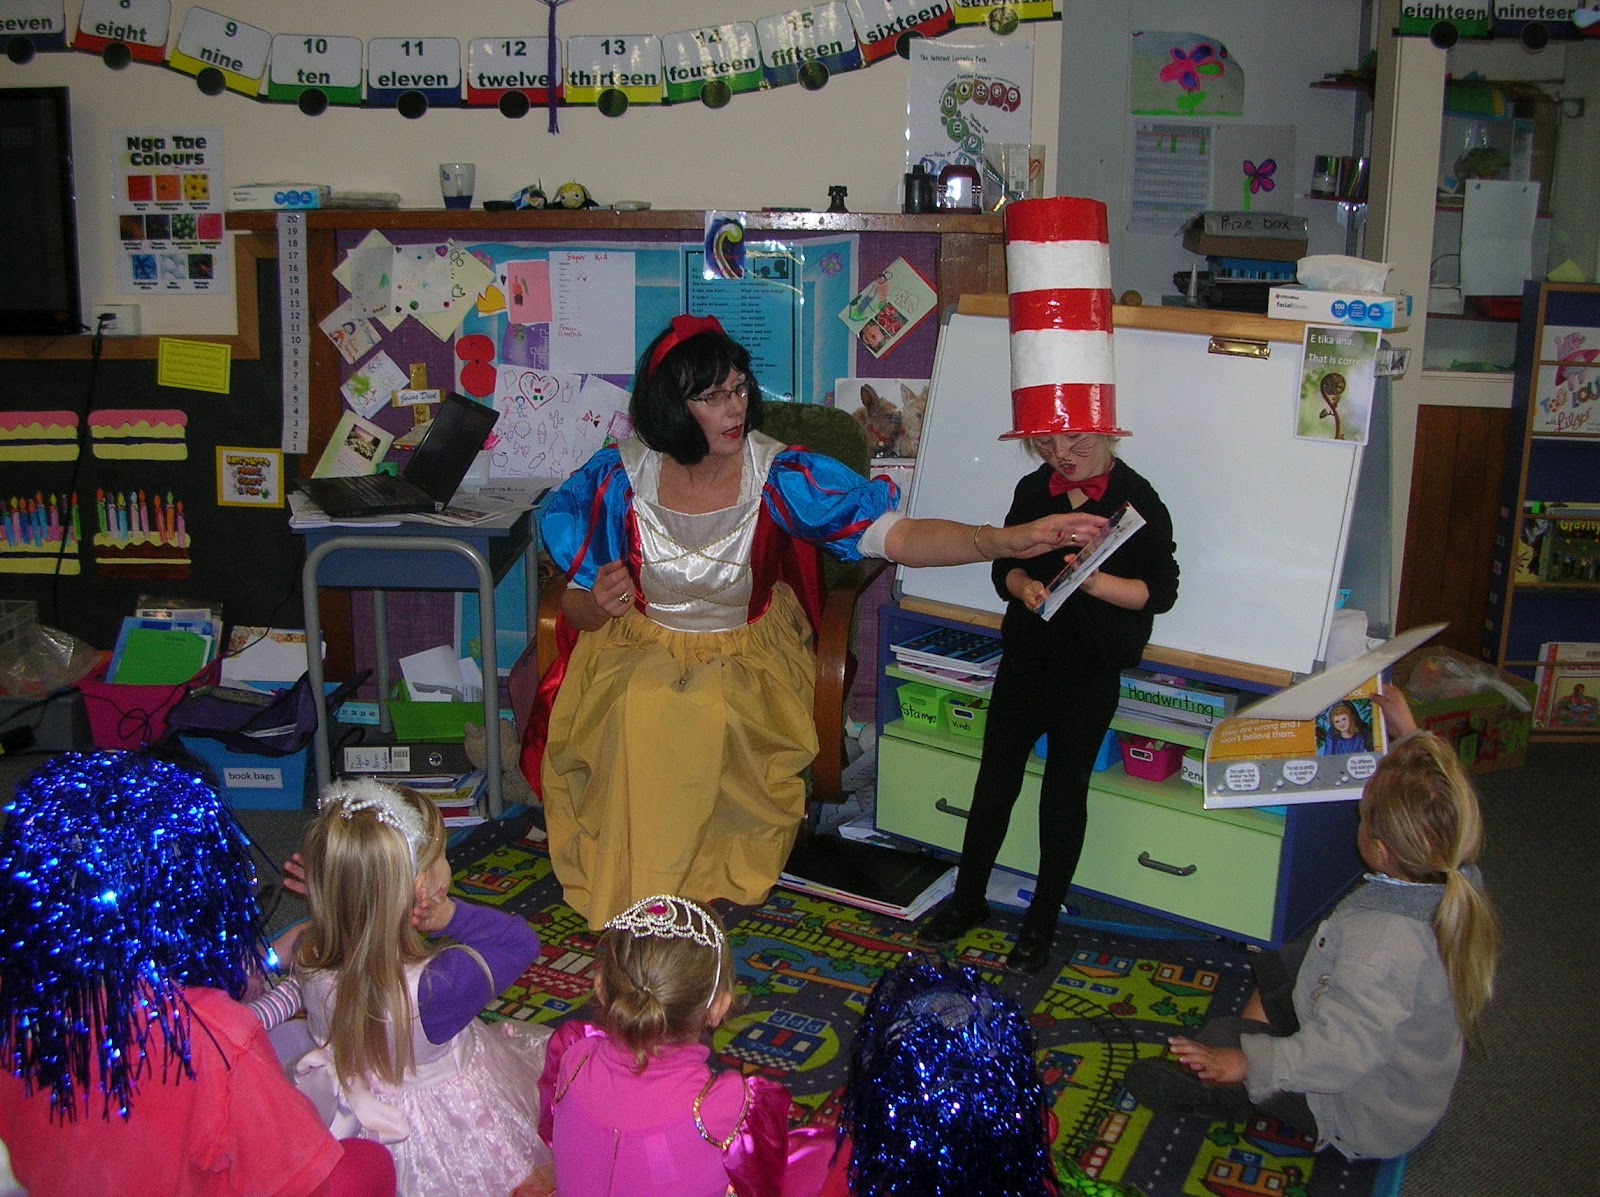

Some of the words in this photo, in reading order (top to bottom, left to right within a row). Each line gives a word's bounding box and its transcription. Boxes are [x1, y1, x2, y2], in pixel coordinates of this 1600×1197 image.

[1404, 5, 1486, 21] eighteen
[225, 22, 238, 37] 9
[866, 3, 945, 44] sixteen
[95, 21, 147, 42] eight
[303, 38, 328, 54] 10
[401, 41, 424, 56] 11
[501, 41, 527, 56] 12
[601, 39, 626, 55] 13
[200, 47, 244, 72] nine
[771, 40, 843, 68] fifteen
[297, 69, 331, 84] ten
[669, 57, 756, 81] fourteen
[378, 71, 448, 87] eleven
[477, 71, 549, 87] twelve
[569, 71, 656, 86] thirteen
[127, 136, 166, 152] Nga
[172, 136, 207, 150] Tae
[130, 151, 205, 166] Colours
[287, 215, 298, 223] 20
[1221, 215, 1252, 231] Prize
[1263, 215, 1291, 231] box
[288, 227, 298, 235] 19
[566, 253, 587, 262] Super
[594, 253, 608, 261] Kid
[289, 264, 299, 272] 16
[291, 336, 301, 344] 10
[1310, 334, 1316, 343] E
[1317, 334, 1334, 345] tika
[1335, 338, 1355, 347] ana.
[1308, 353, 1328, 364] That
[1329, 355, 1337, 365] is
[401, 394, 419, 404] Jesus
[420, 391, 437, 400] Died
[1128, 683, 1214, 724] Handwriting
[901, 702, 937, 724] Stamps
[1254, 723, 1279, 731] wrong
[1220, 736, 1241, 744] won't
[1243, 732, 1271, 741] believe
[1272, 730, 1296, 739] them.
[228, 771, 252, 780] book
[254, 771, 275, 781] bags
